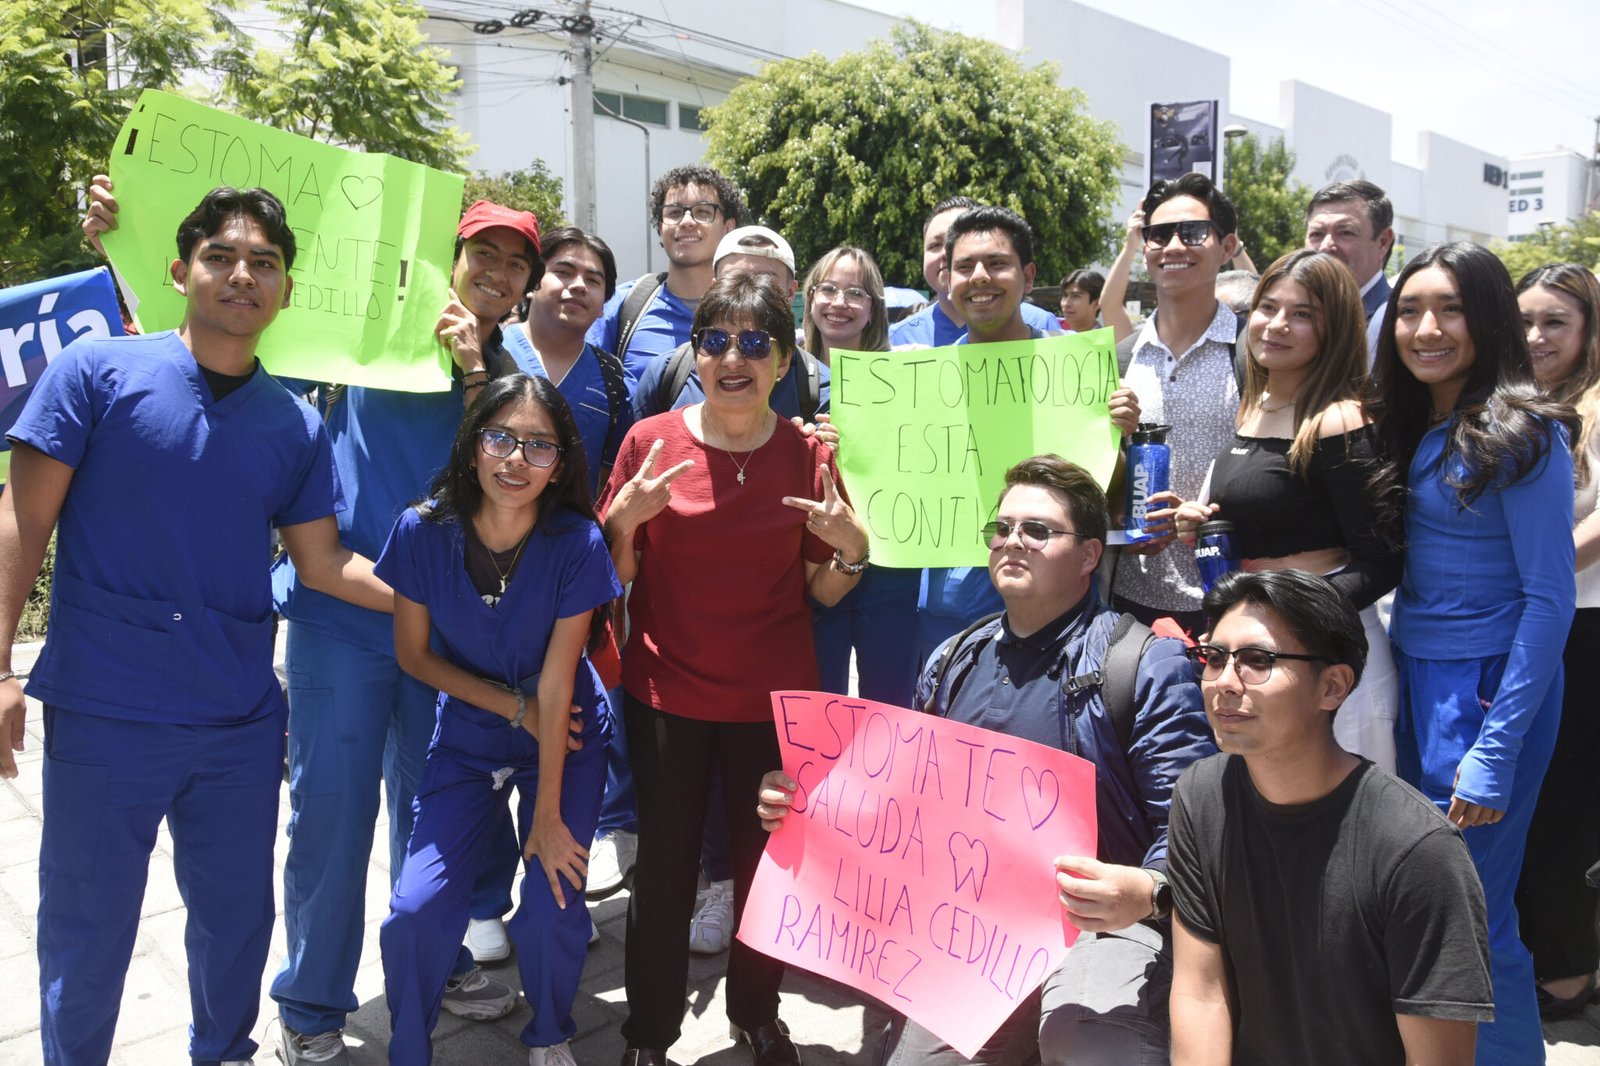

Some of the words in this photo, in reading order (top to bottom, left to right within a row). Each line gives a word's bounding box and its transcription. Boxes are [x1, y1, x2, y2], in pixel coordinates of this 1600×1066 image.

[1509, 199, 1529, 213] ED
[1534, 198, 1543, 211] 3
[294, 281, 383, 321] EDILLO.
[840, 350, 1118, 408] ESTOMATOLOGIA
[897, 424, 983, 476] ESTA
[1132, 463, 1150, 519] BUAP
[780, 695, 943, 800] ESTOMA
[956, 739, 1016, 821] TE
[788, 761, 925, 876] SALUDA
[775, 894, 922, 1002] RAMIREZ
[833, 857, 913, 935] LILIA
[929, 902, 1049, 1005] CEDILLO
